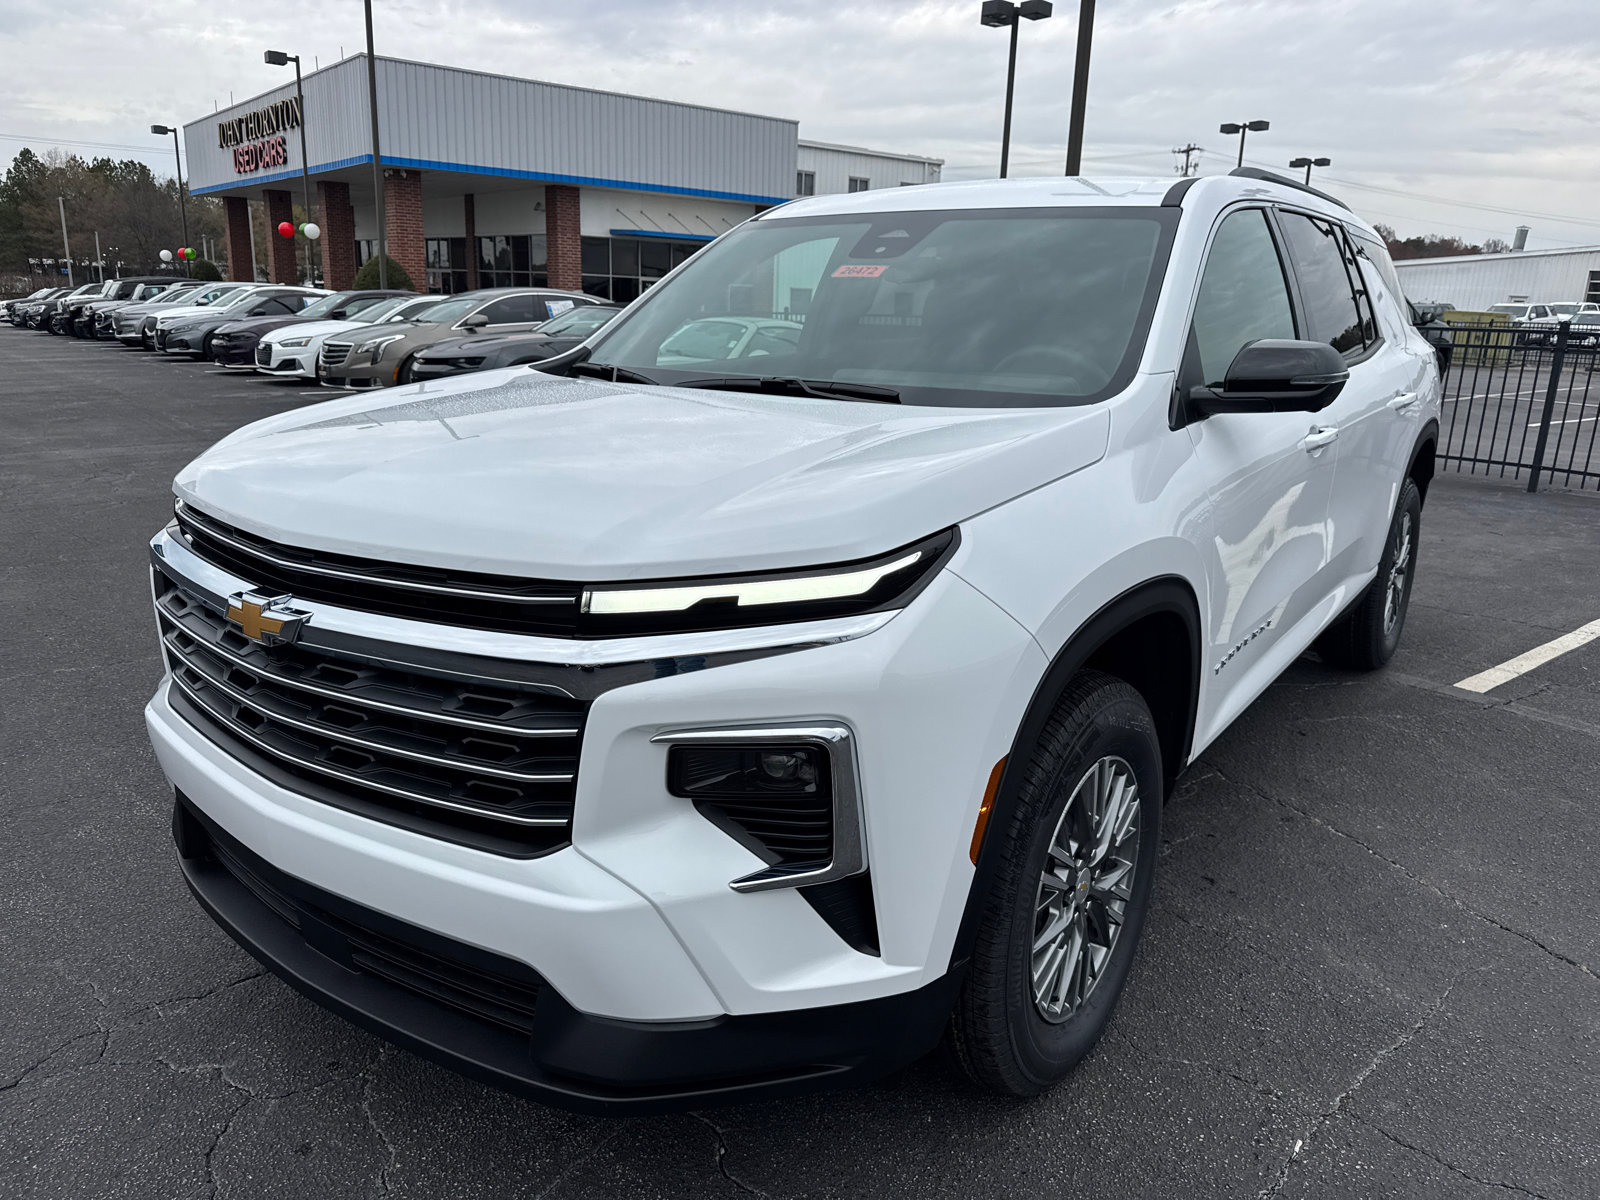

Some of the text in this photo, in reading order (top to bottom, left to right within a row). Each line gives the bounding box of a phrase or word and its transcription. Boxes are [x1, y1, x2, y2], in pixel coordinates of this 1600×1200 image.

[217, 95, 303, 149] JOHN THORNTON
[232, 136, 287, 174] USED CARS
[840, 266, 879, 275] 26472
